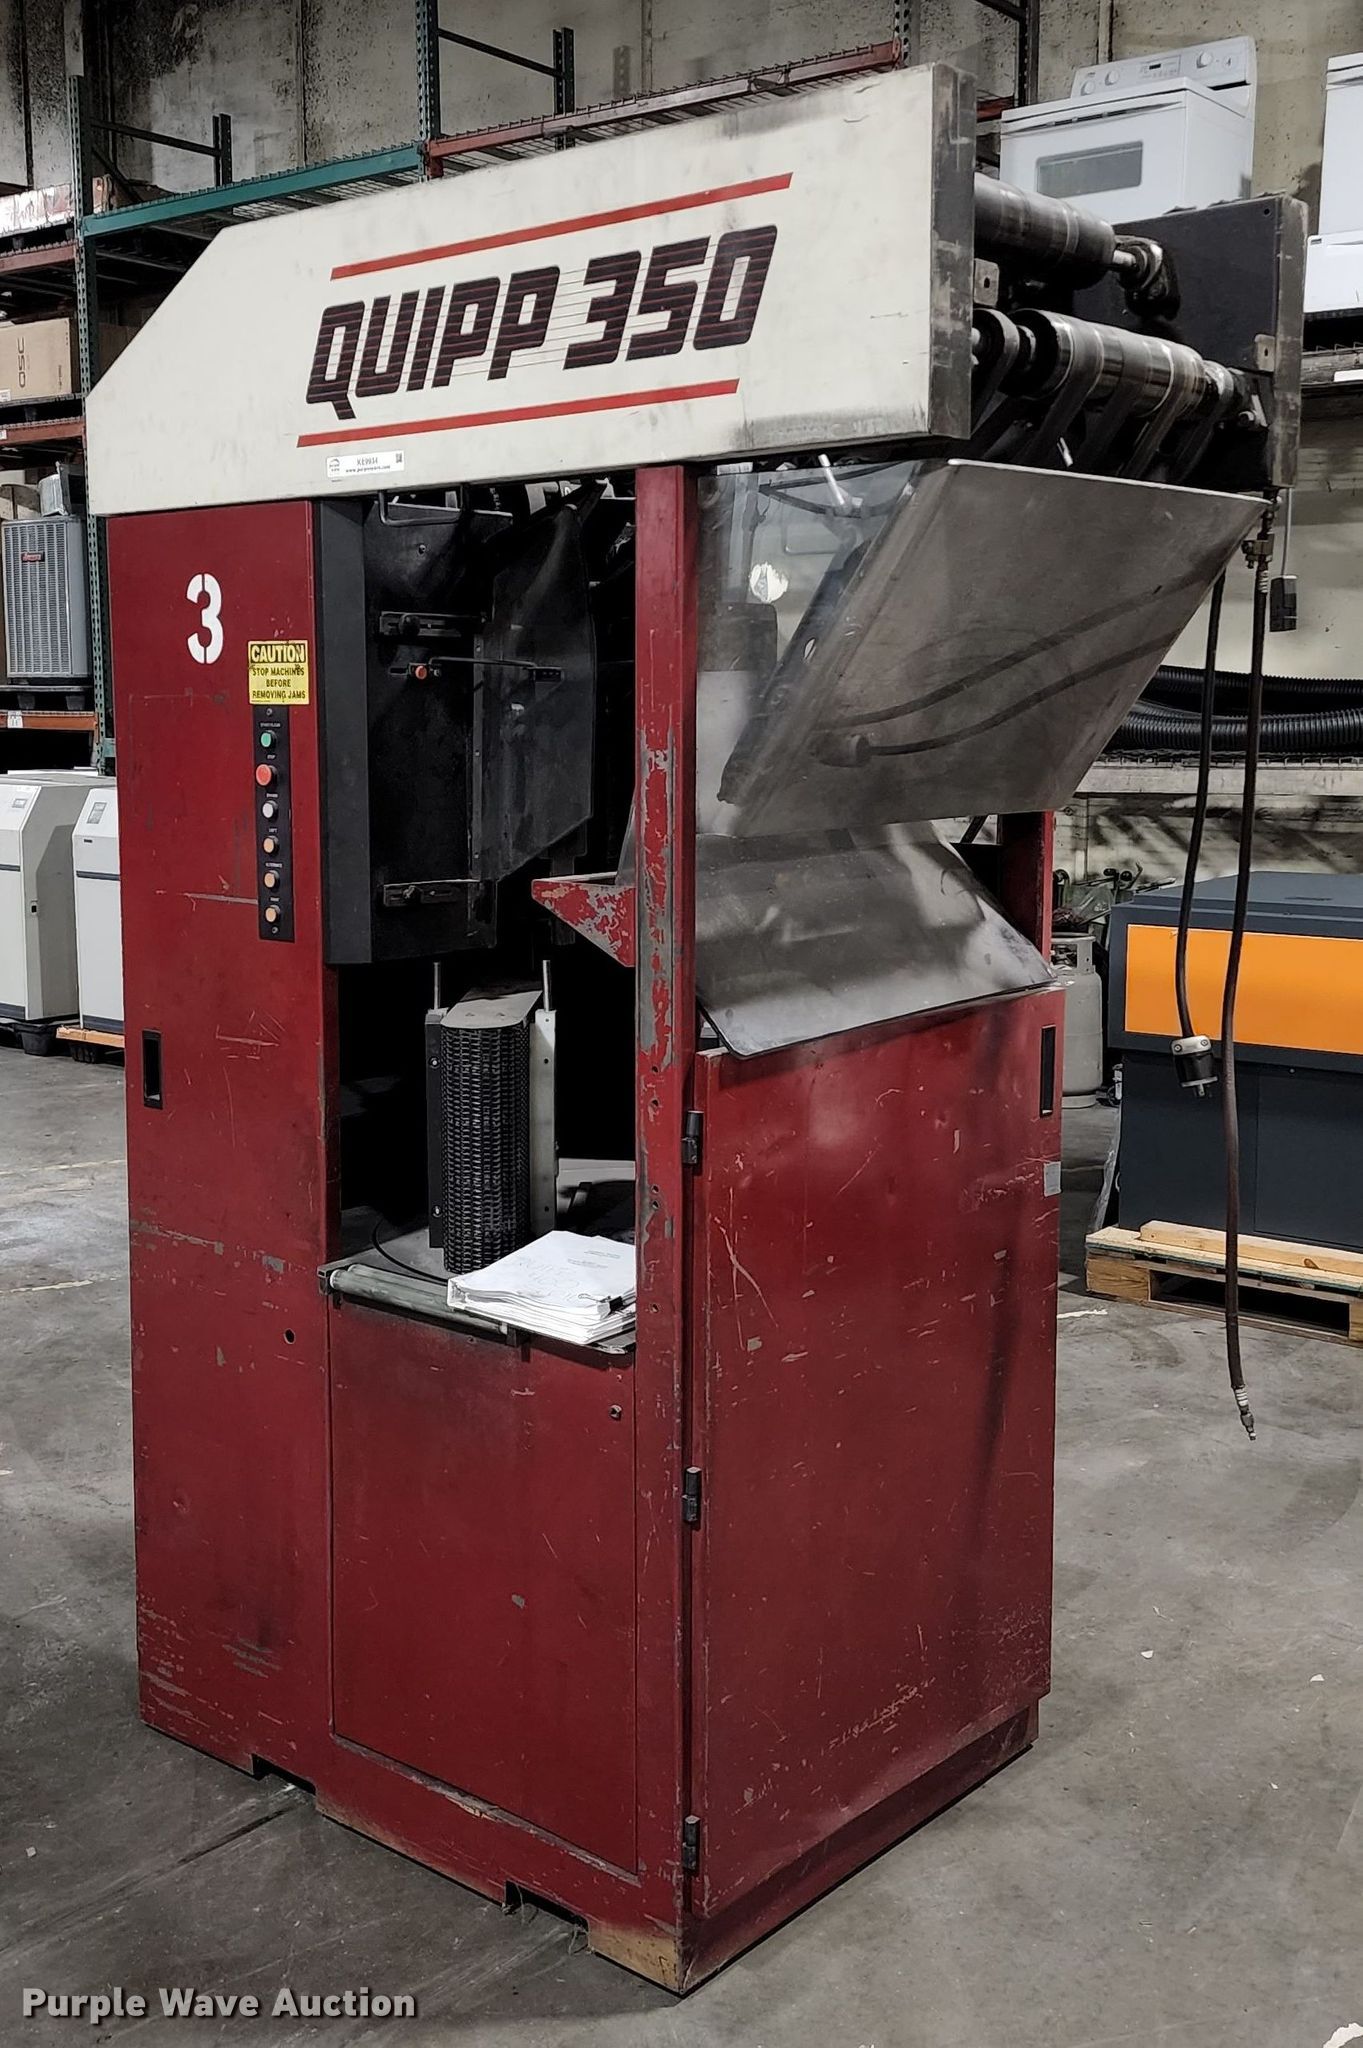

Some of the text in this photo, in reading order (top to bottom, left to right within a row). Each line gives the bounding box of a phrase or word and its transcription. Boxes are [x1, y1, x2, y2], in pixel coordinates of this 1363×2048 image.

[306, 224, 778, 419] QUIPP 350
[186, 573, 224, 664] 3
[251, 644, 305, 663] CAUTION
[252, 667, 304, 676] STOP MACHINES
[266, 679, 291, 688] BEFORE
[252, 690, 306, 700] REMOVING JAMS
